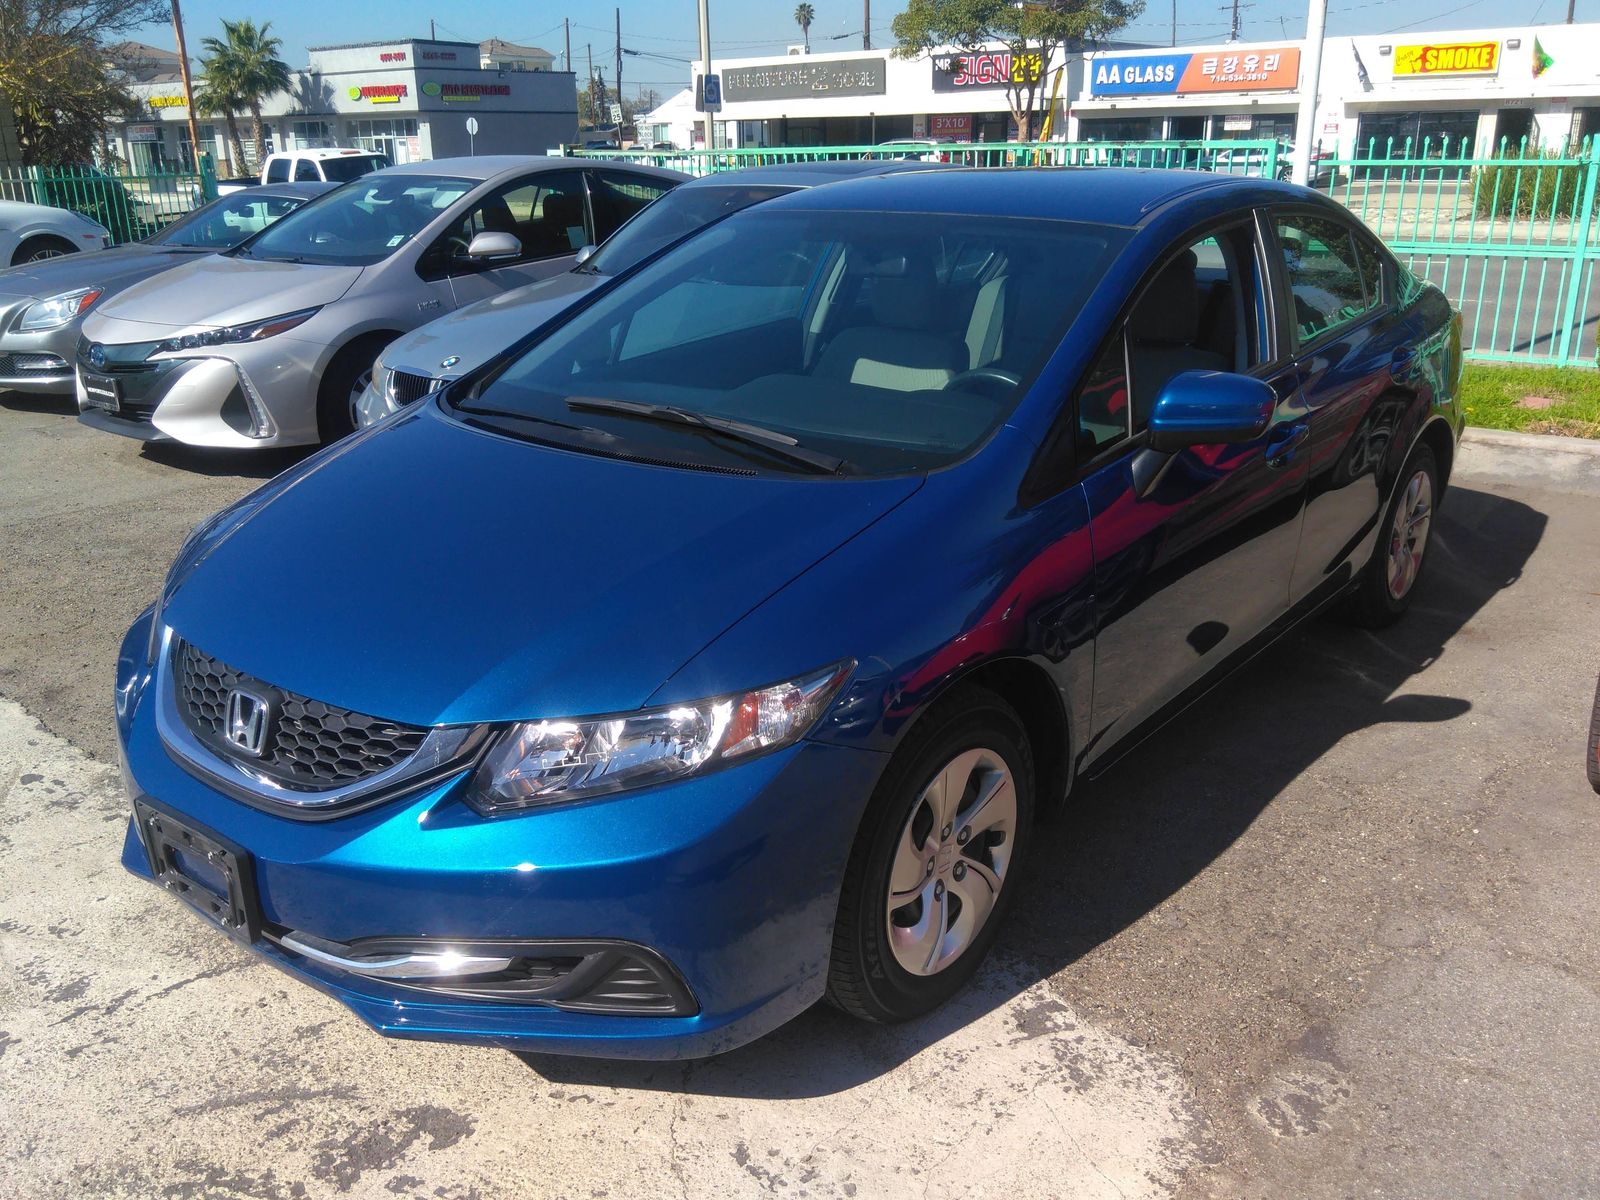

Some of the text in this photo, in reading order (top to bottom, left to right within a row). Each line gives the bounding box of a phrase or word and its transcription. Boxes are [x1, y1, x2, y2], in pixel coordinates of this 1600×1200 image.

[1202, 54, 1281, 75] 금강유리
[1425, 47, 1491, 70] SMOKE
[954, 54, 1011, 85] SIGN
[1096, 64, 1175, 85] AA GLASS
[613, 114, 622, 122] 25
